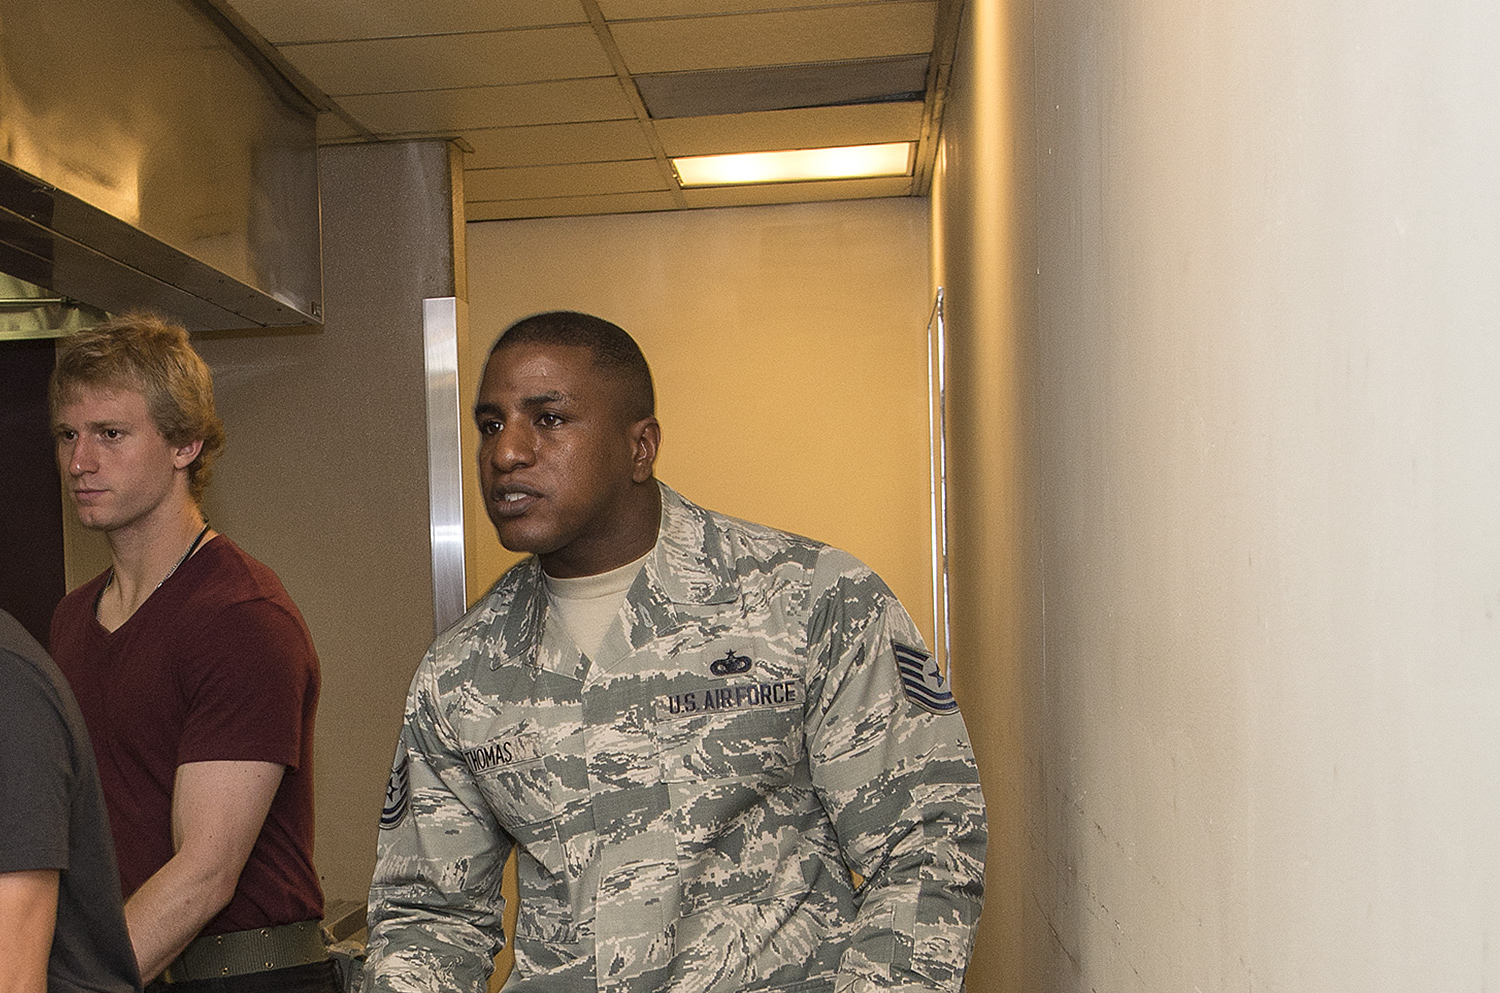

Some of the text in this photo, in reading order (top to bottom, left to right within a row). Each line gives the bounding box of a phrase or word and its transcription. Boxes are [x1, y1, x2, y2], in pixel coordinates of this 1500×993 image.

[669, 681, 796, 715] U.S. AIR FORCE
[464, 741, 512, 772] THOMAS
